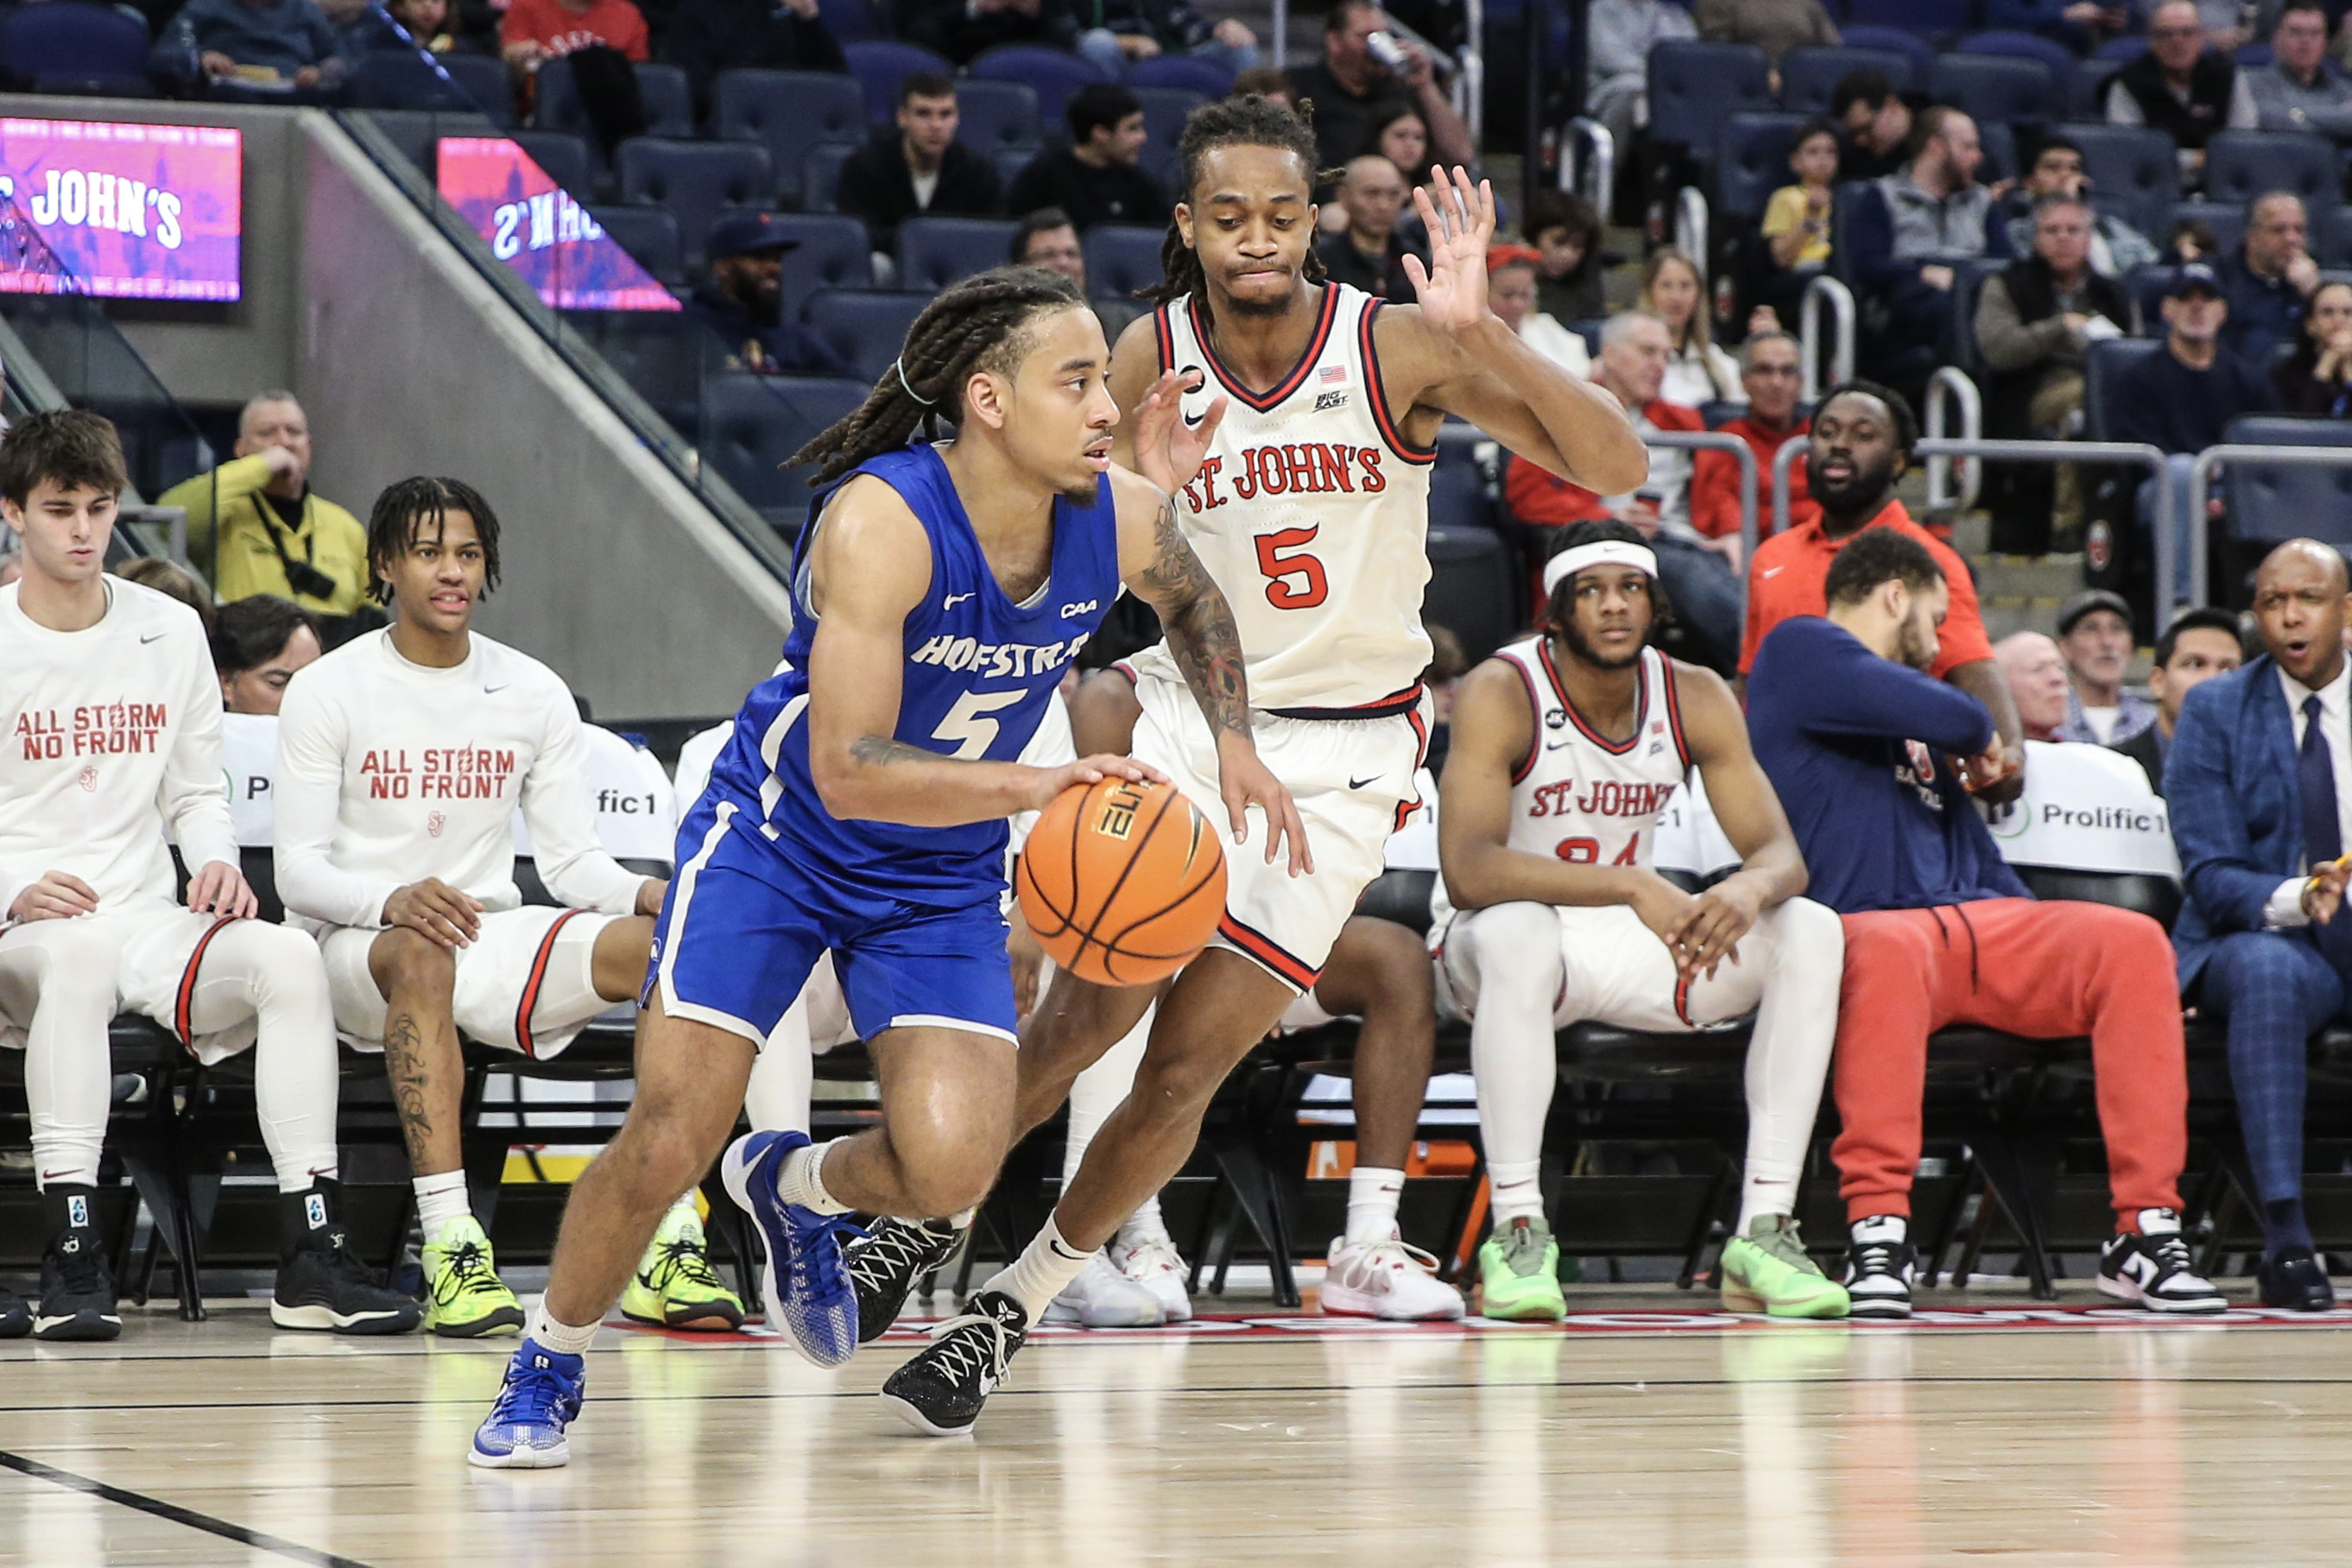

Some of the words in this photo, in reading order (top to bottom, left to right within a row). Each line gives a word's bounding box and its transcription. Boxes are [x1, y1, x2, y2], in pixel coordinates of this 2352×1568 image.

[30, 169, 183, 250] JOHN'S
[1233, 443, 1387, 500] JOHN'S
[1254, 522, 1329, 610] 5
[1060, 599, 1098, 619] CAA
[14, 710, 66, 737] ALL
[73, 701, 167, 731] STORM
[930, 689, 1030, 762] 5
[23, 735, 63, 761] NO
[73, 730, 160, 757] FRONT
[360, 749, 413, 775] ALL
[423, 746, 515, 774] STORM
[370, 775, 409, 800] NO
[420, 775, 508, 800] FRONT
